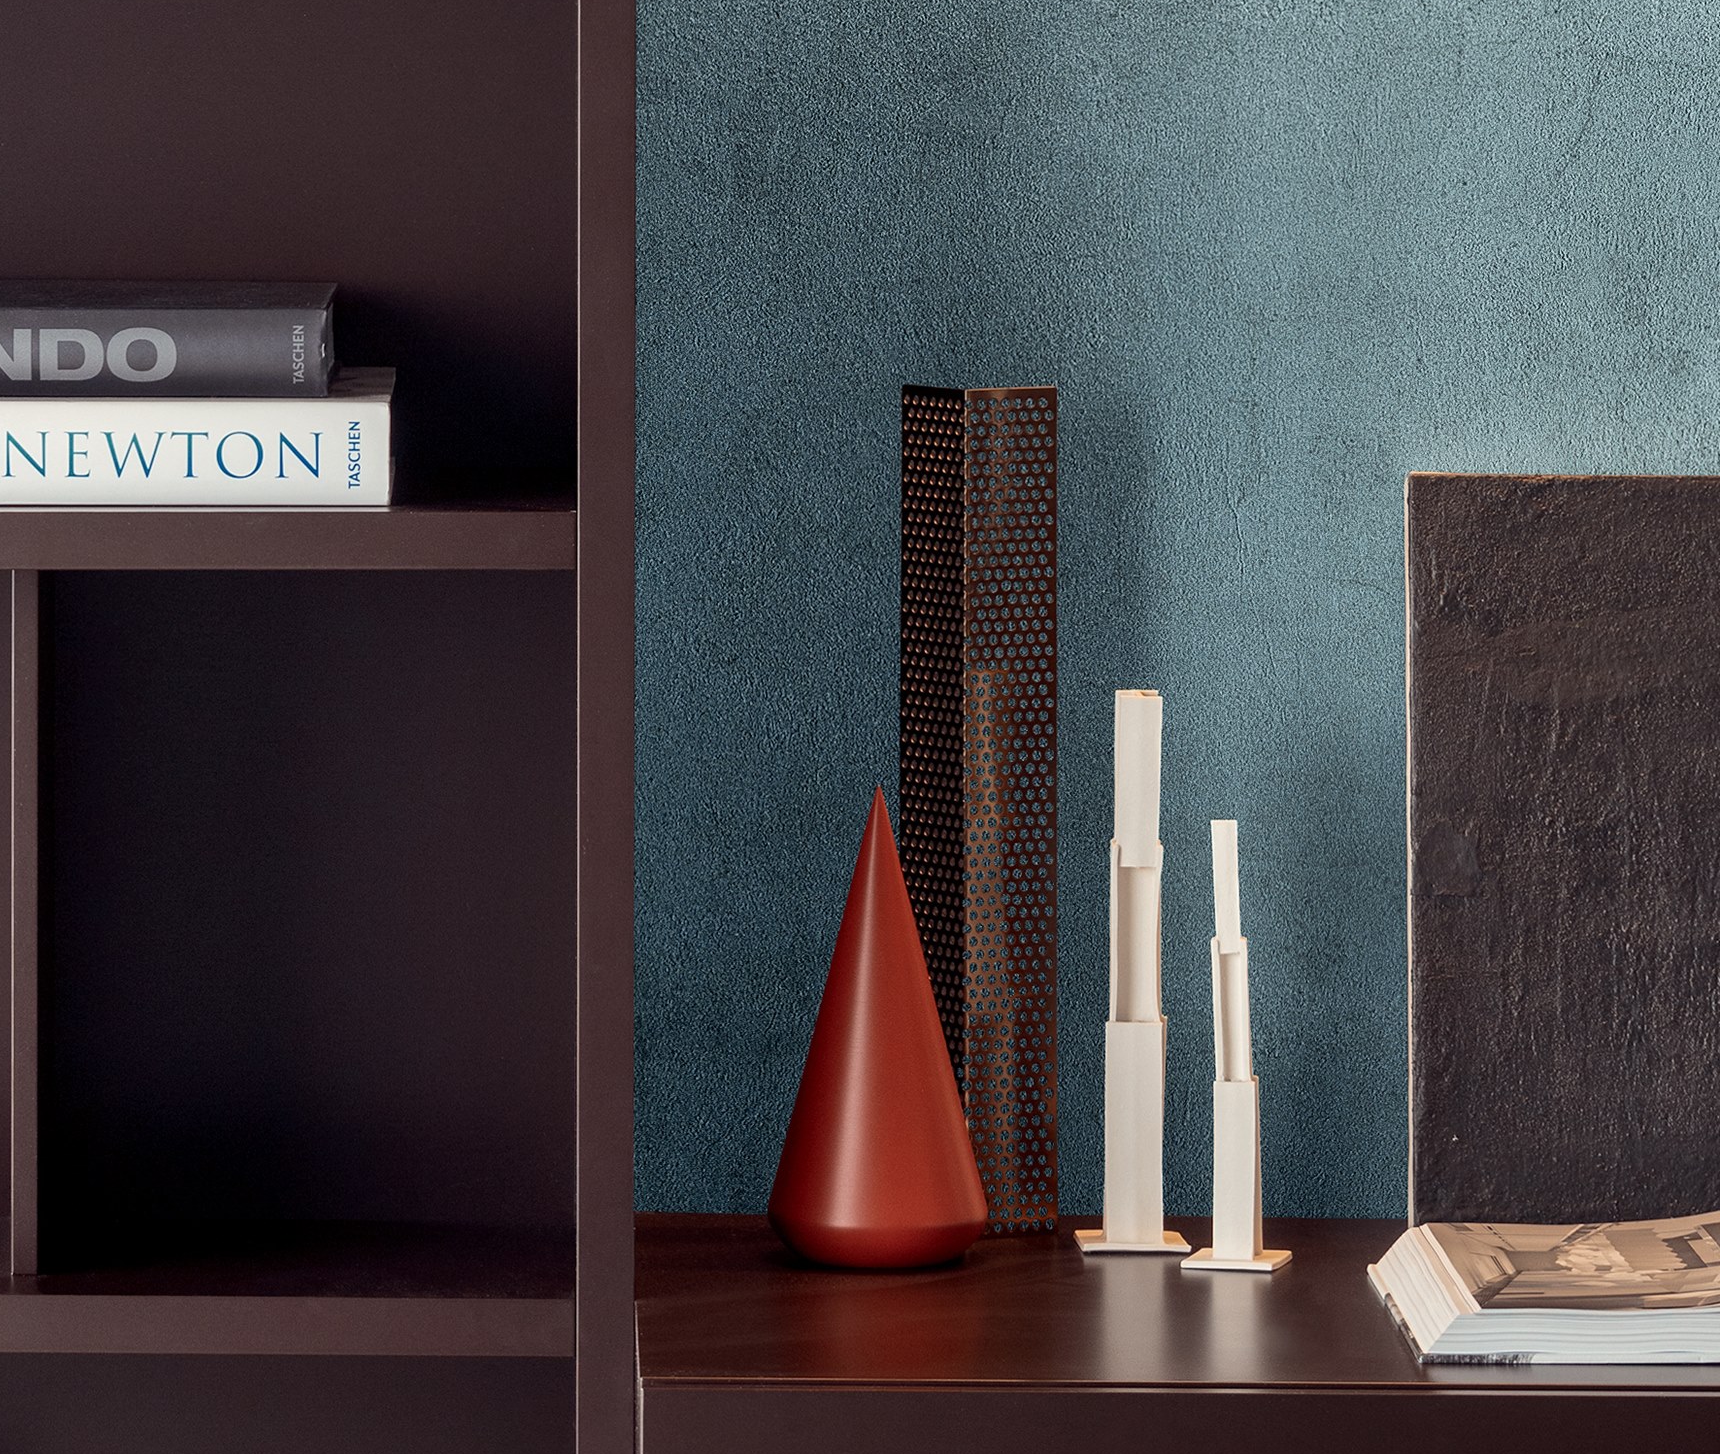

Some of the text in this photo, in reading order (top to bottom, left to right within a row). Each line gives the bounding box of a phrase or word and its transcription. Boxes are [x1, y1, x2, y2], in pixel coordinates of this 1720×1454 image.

[292, 324, 305, 385] TASCHEN
[1, 430, 323, 479] NEWTON
[347, 421, 361, 489] TASCHEN
